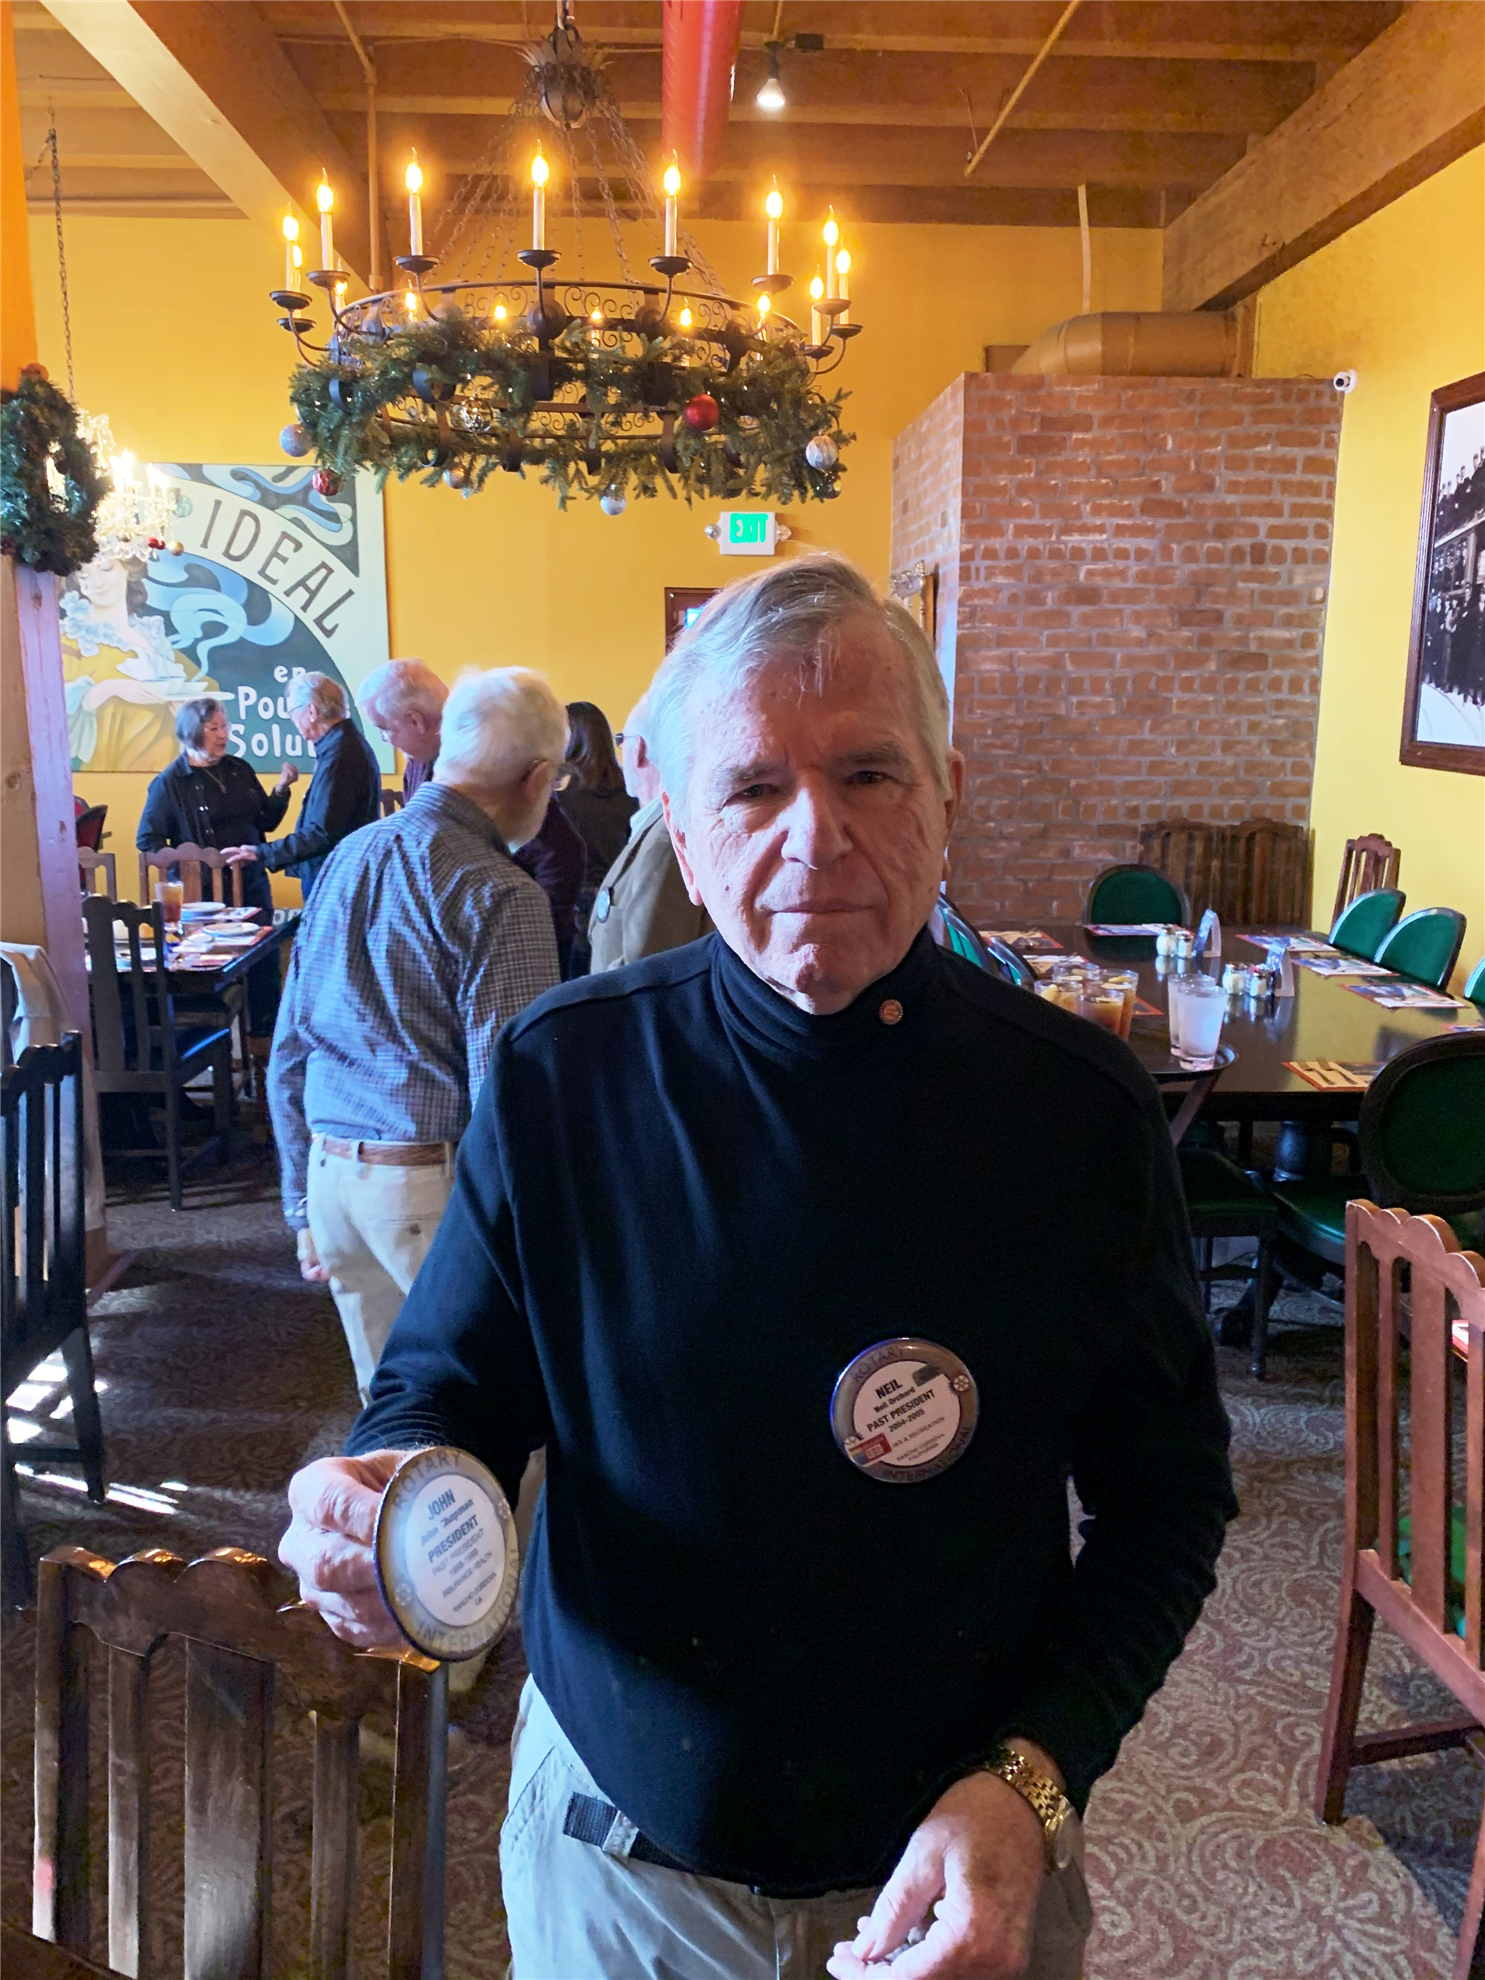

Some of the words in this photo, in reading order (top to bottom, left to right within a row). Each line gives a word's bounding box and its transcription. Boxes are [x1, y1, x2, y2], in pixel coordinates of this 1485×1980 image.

[729, 513, 769, 544] EXIT
[200, 499, 355, 639] IDEAL
[237, 685, 292, 720] Pou
[873, 1399, 888, 1413] Neil
[889, 1386, 916, 1406] Orchard
[875, 1378, 903, 1399] NEIL
[866, 1413, 890, 1433] PAST
[889, 1388, 936, 1420] PRESIDENT
[888, 1410, 926, 1433] 2004-2005
[393, 1449, 461, 1508] ROTARY
[427, 1488, 456, 1521] JOHN
[440, 1498, 474, 1529] Chapman
[427, 1513, 478, 1564] PRESIDENT
[449, 1527, 484, 1560] PRESIDENT
